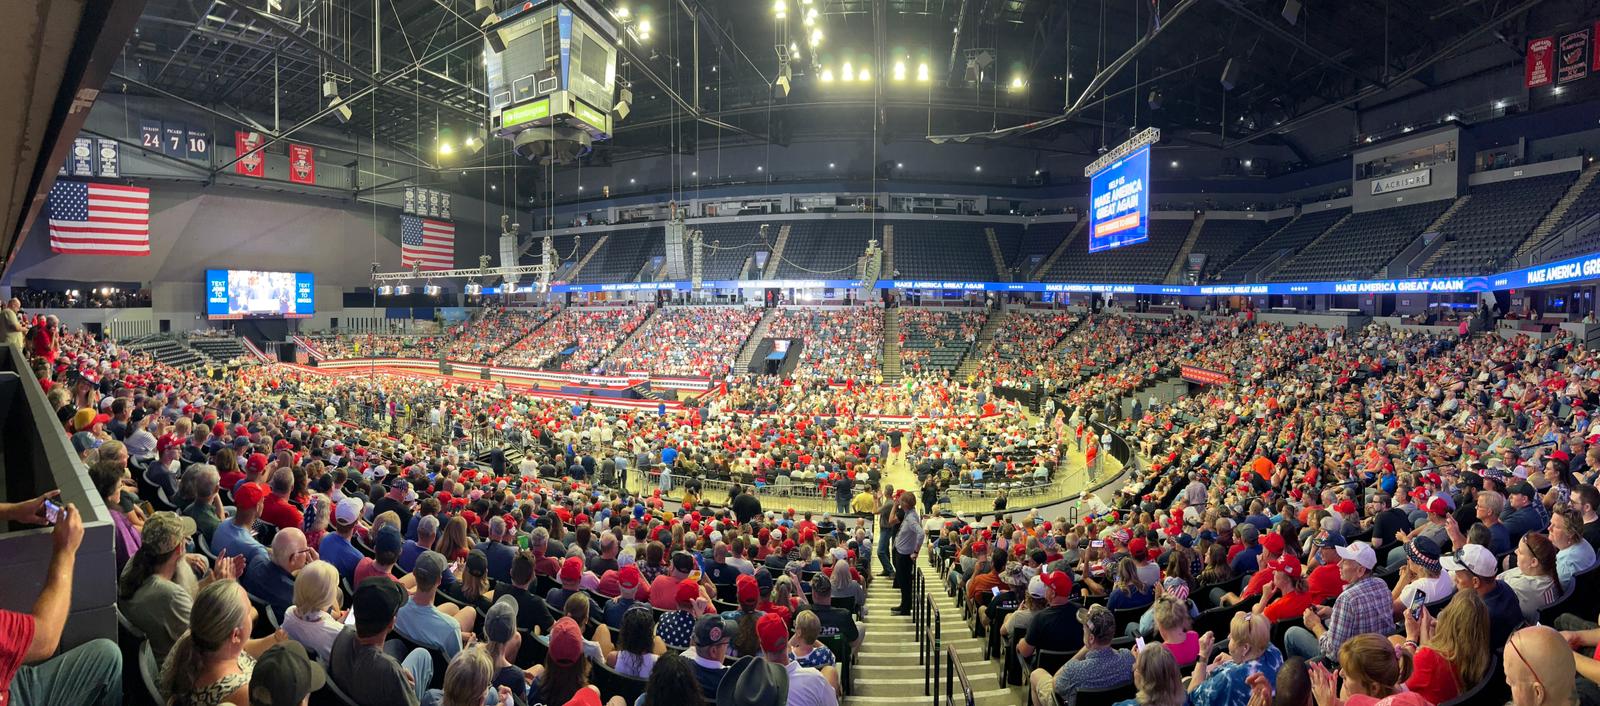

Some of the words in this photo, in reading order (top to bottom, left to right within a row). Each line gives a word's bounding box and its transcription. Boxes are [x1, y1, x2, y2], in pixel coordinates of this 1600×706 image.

[143, 133, 160, 147] 24
[171, 136, 179, 150] 7
[189, 138, 206, 152] 10
[1108, 178, 1119, 190] HELP
[1118, 175, 1125, 185] US
[1385, 175, 1425, 190] ACRISURE
[1094, 191, 1111, 209] MAKE
[1111, 178, 1143, 202] AMERICA
[1096, 201, 1117, 220] GREAT
[1116, 193, 1139, 213] AGAIN
[1527, 271, 1546, 284] MAKE
[1546, 262, 1581, 281] AMERICA
[1335, 283, 1357, 292] MAKE
[1358, 282, 1395, 292] AMERICA
[1397, 281, 1428, 291] GREAT
[1431, 280, 1464, 290] AGAIN
